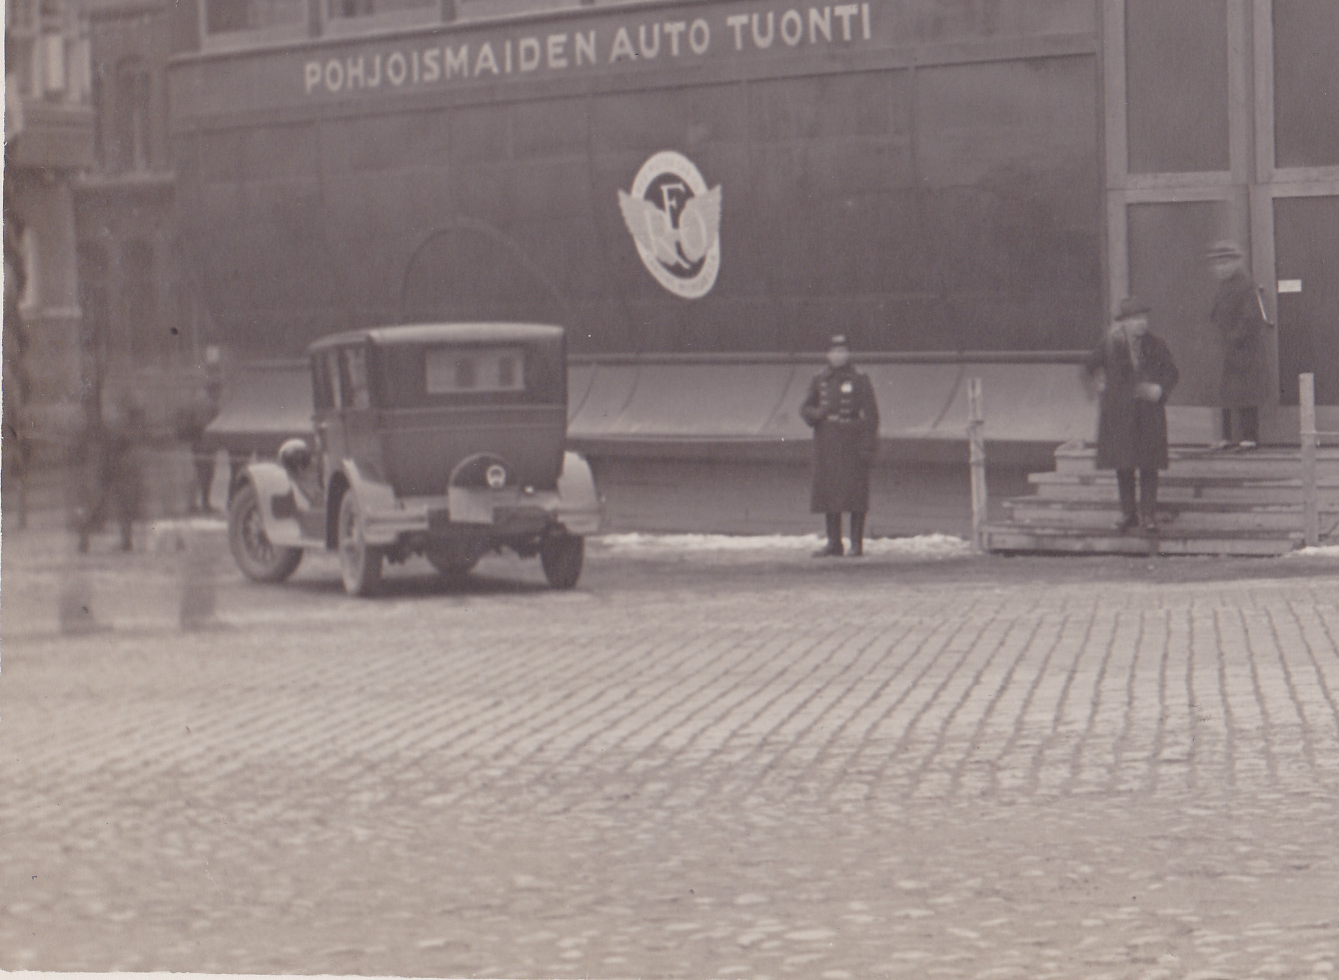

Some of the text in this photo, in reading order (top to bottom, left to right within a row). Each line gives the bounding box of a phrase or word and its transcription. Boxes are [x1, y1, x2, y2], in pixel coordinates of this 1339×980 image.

[303, 2, 872, 95] POHJOISMAIDEN AUTO TUONTI
